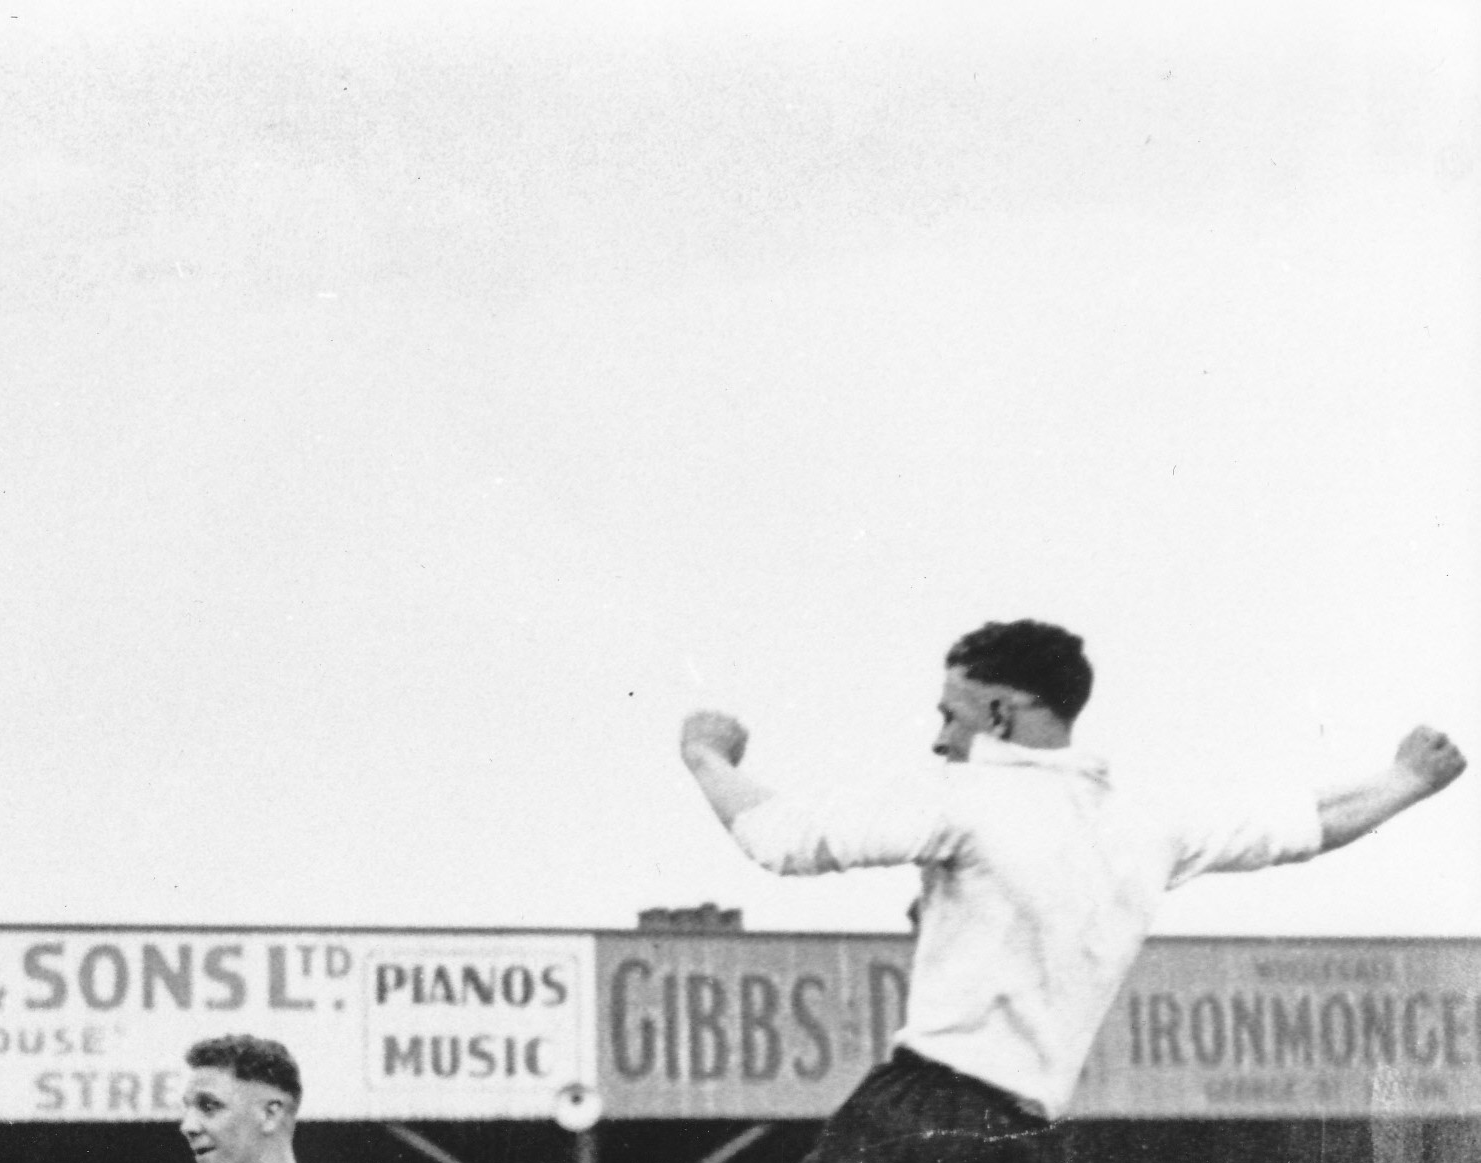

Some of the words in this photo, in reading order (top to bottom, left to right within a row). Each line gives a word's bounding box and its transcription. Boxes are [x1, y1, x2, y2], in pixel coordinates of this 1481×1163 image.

[21, 942, 248, 1012] SONS
[375, 962, 569, 1008] PIANOS
[610, 956, 833, 1082] GIBBS
[1127, 988, 1481, 1068] IRONMONGE
[382, 1034, 550, 1080] MUSIC
[31, 1070, 180, 1115] STRE
